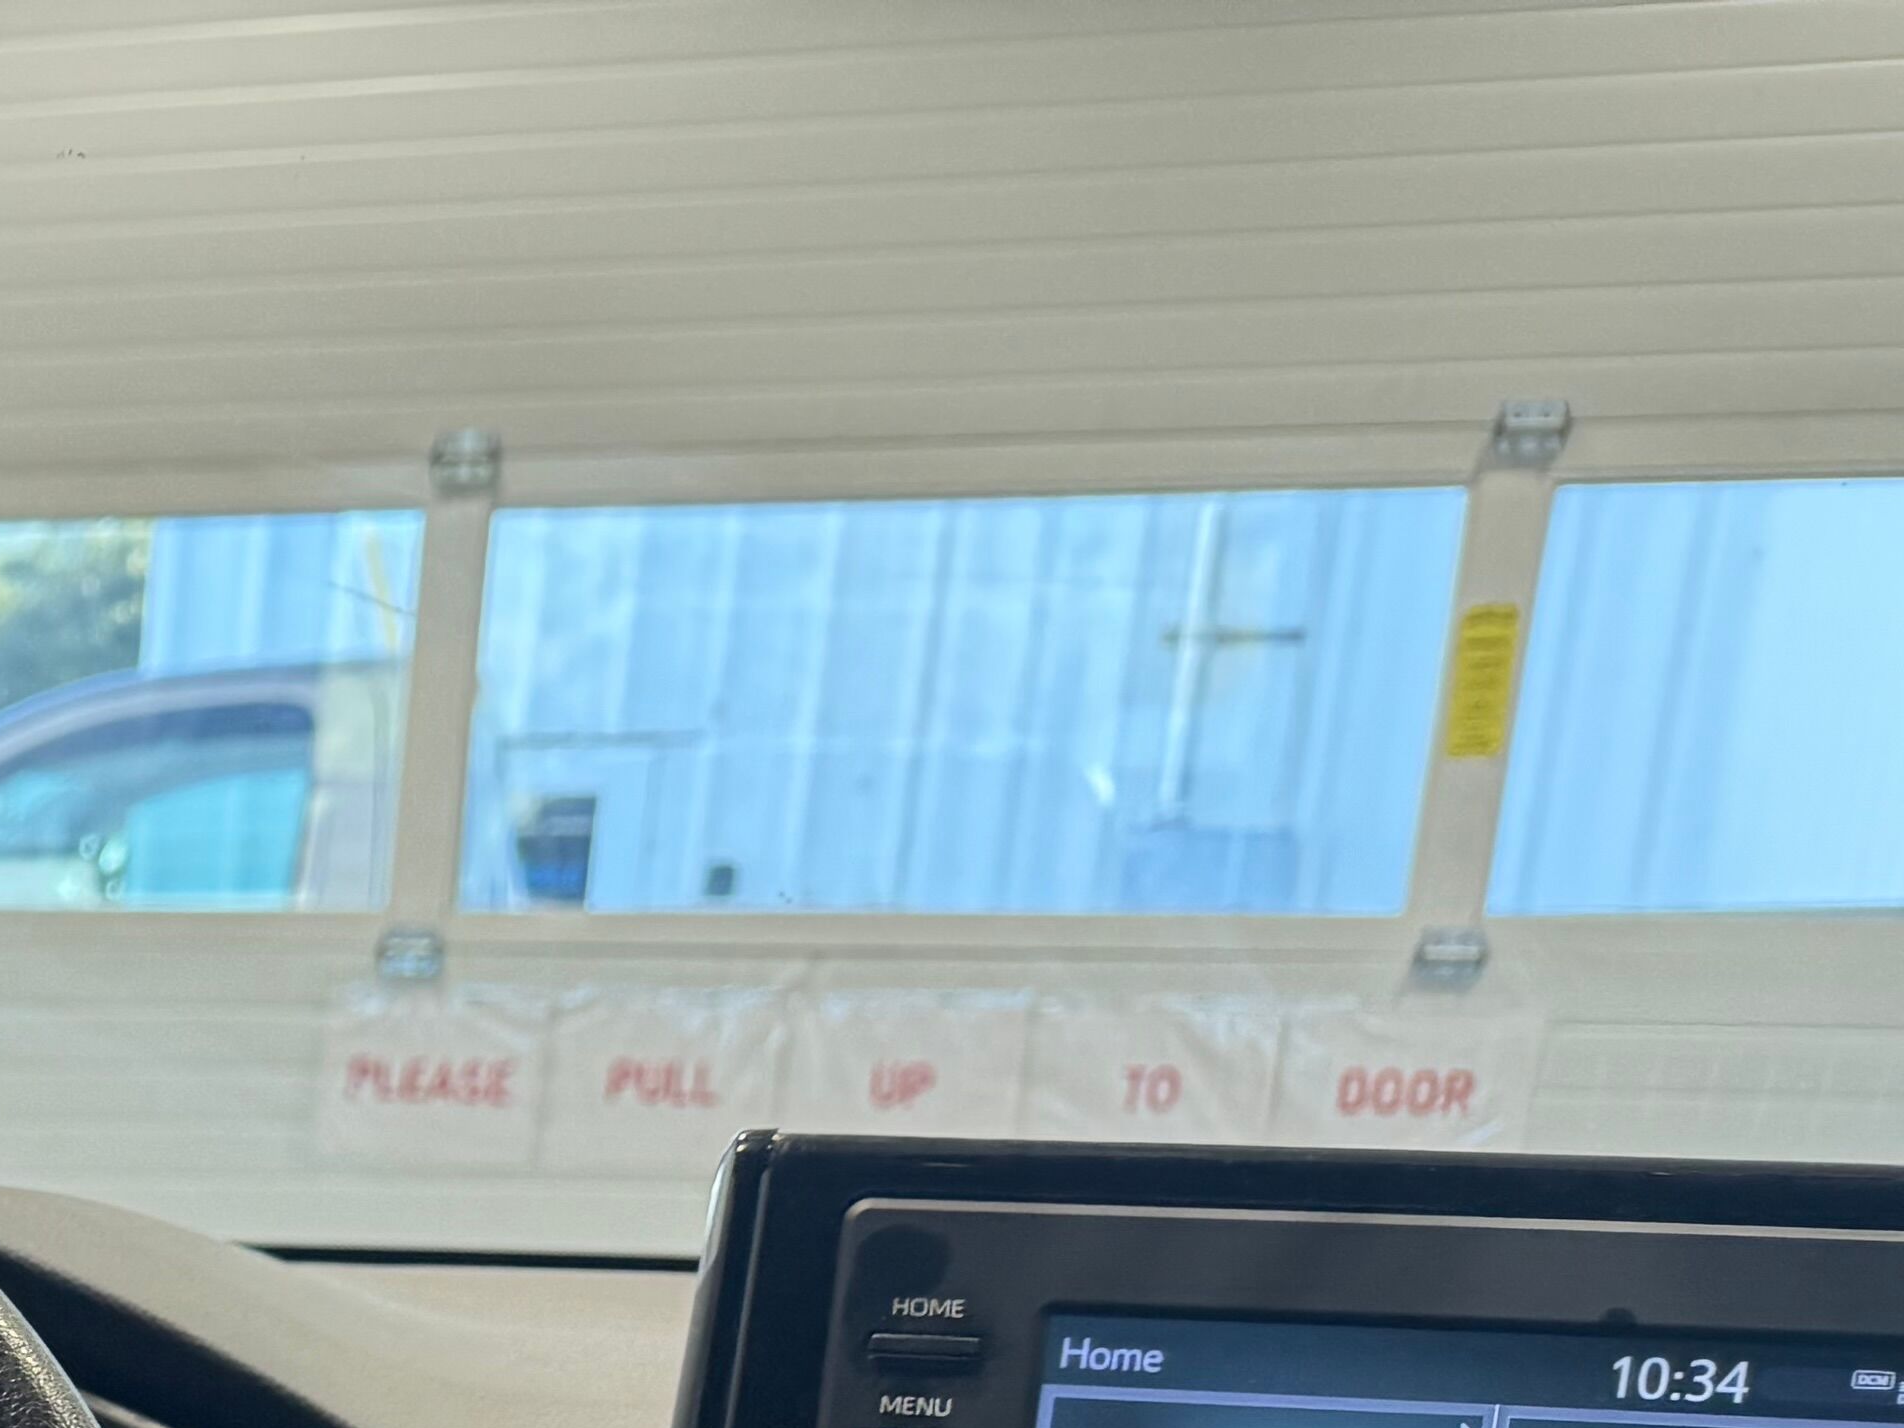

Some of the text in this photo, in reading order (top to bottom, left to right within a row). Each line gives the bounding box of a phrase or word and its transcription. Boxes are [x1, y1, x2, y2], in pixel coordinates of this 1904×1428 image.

[343, 1056, 1477, 1118] PLEASE PULL UP TO DOOR
[892, 1296, 965, 1319] HOME
[1059, 1336, 1165, 1374] Home
[1612, 1355, 1750, 1403] 10:34
[878, 1394, 953, 1418] MENU
